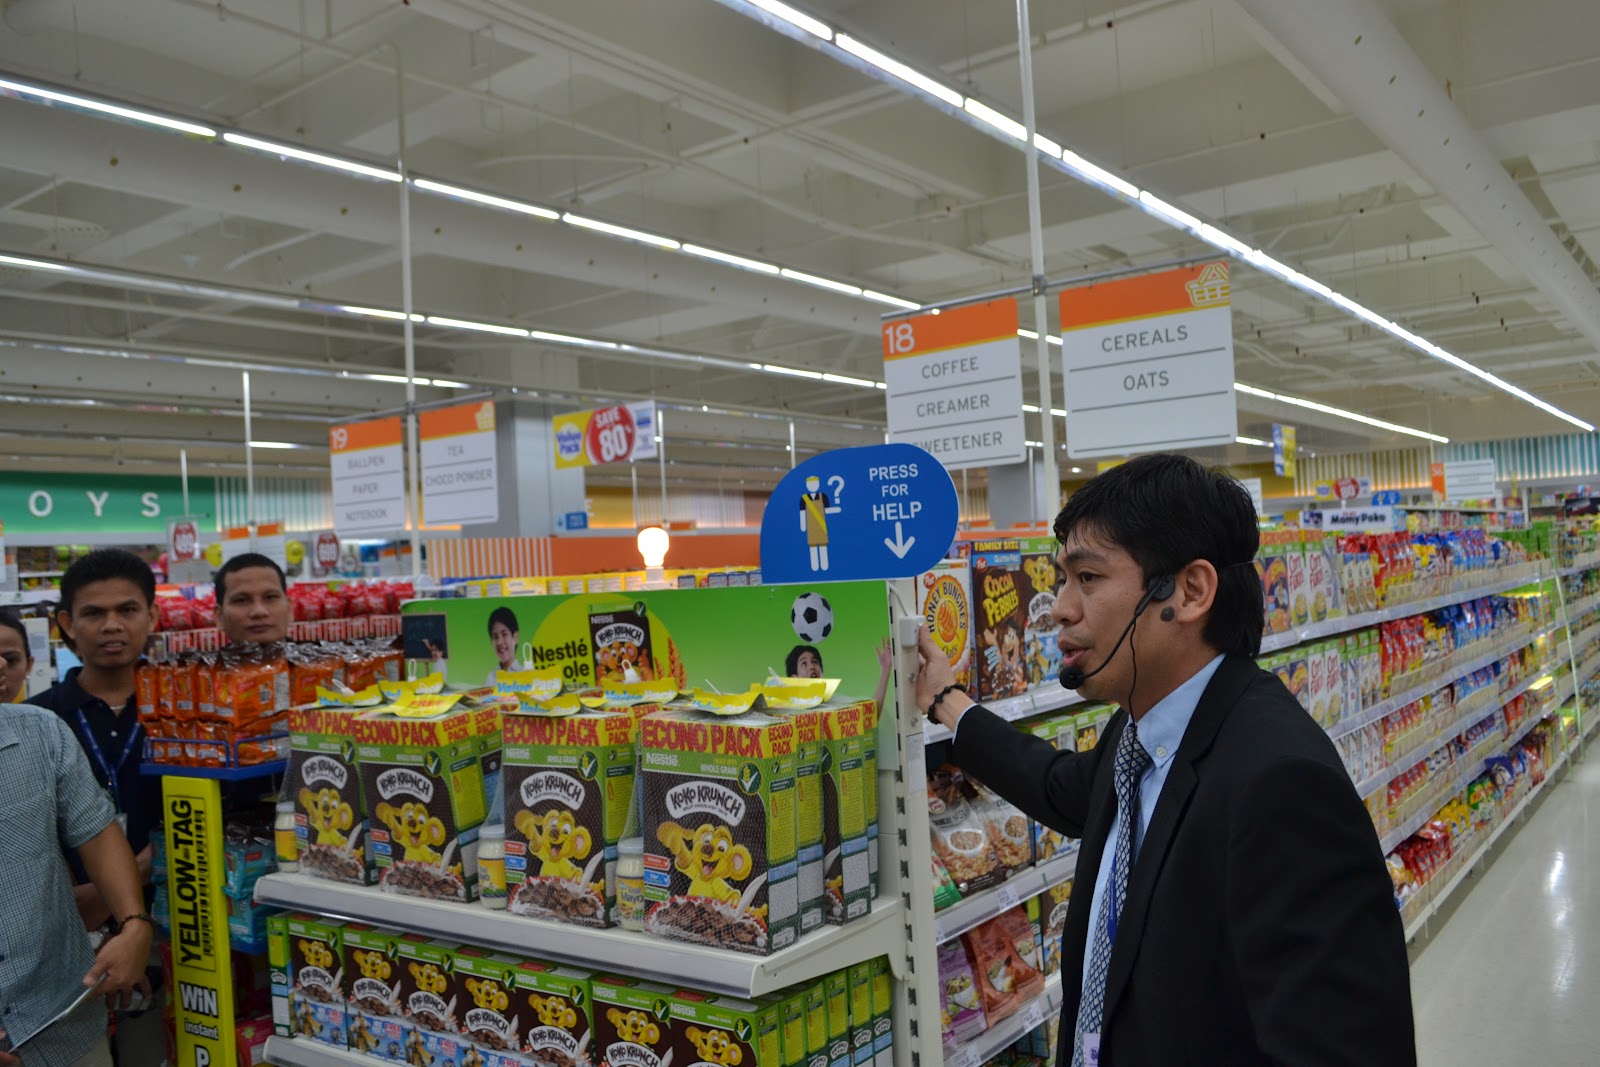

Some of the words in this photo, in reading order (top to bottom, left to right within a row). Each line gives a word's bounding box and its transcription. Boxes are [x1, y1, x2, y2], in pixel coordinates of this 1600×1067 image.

[884, 322, 915, 353] 18
[1101, 325, 1188, 353] CEREALS
[921, 356, 980, 379] COFFEE
[1123, 370, 1169, 391] OATS
[916, 394, 990, 418] CREAMER
[596, 406, 621, 428] SAVE
[330, 428, 348, 450] 19
[556, 430, 582, 442] Value
[912, 431, 1002, 453] WEETENER
[448, 445, 464, 456] TEA
[347, 454, 385, 470] BALLPEN
[425, 472, 452, 487] CHOCO
[455, 468, 492, 484] POWDER
[869, 464, 918, 481] PRESS
[352, 482, 379, 494] PAPER
[882, 484, 909, 498] FOR
[28, 490, 161, 518] OYS
[872, 501, 922, 522] HELP
[345, 508, 388, 522] NOTEBOOK
[974, 540, 1002, 552] FAMILY
[1004, 540, 1019, 550] SIZE
[924, 575, 936, 586] Post
[984, 573, 1015, 598] COCOA
[927, 590, 941, 634] HONEY
[943, 582, 966, 630] BUNCHES
[983, 588, 1019, 627] PEBBLES
[614, 626, 642, 644] KRUNCH
[532, 638, 588, 664] Nestlé
[498, 680, 532, 692] Value
[605, 690, 642, 700] Value
[288, 710, 323, 734] ECONO
[442, 712, 470, 732] ECONO
[605, 716, 632, 732] ECONO
[796, 713, 818, 728] ECONO
[838, 708, 860, 724] ECONO
[354, 720, 400, 745] ECONO
[401, 720, 441, 746] PACK
[448, 728, 470, 744] PACK
[503, 718, 554, 744] ECONO
[556, 718, 600, 746] PACK
[608, 730, 630, 744] PACK
[642, 720, 708, 752] ECONO
[712, 725, 762, 758] PACK
[769, 724, 793, 742] ECONO
[799, 727, 816, 742] PACK
[841, 722, 859, 737] PACK
[772, 741, 790, 756] PACK
[547, 756, 561, 764] WHOLE
[562, 756, 577, 764] GRAIN
[700, 763, 719, 772] WHOLE
[720, 766, 737, 774] GRAIN
[318, 758, 345, 784] KRUNCH
[380, 774, 397, 791] KOKO
[397, 772, 431, 798] KRUNCH
[524, 780, 544, 798] KOKO
[545, 775, 582, 803] KRUNCH
[670, 786, 696, 810] KOKO
[697, 785, 742, 818] KRUNCH
[621, 892, 644, 904] Mayo
[313, 969, 332, 987] KRUNCH
[369, 982, 390, 1002] KRUNCH
[424, 994, 446, 1016] KRUNCH
[184, 1018, 219, 1040] instant
[482, 1010, 508, 1034] KRUNCH
[531, 1028, 546, 1045] KOKO
[547, 1028, 576, 1053] KRUNCH
[609, 1046, 626, 1062] KOKO
[627, 1045, 659, 1067] KRUNCH
